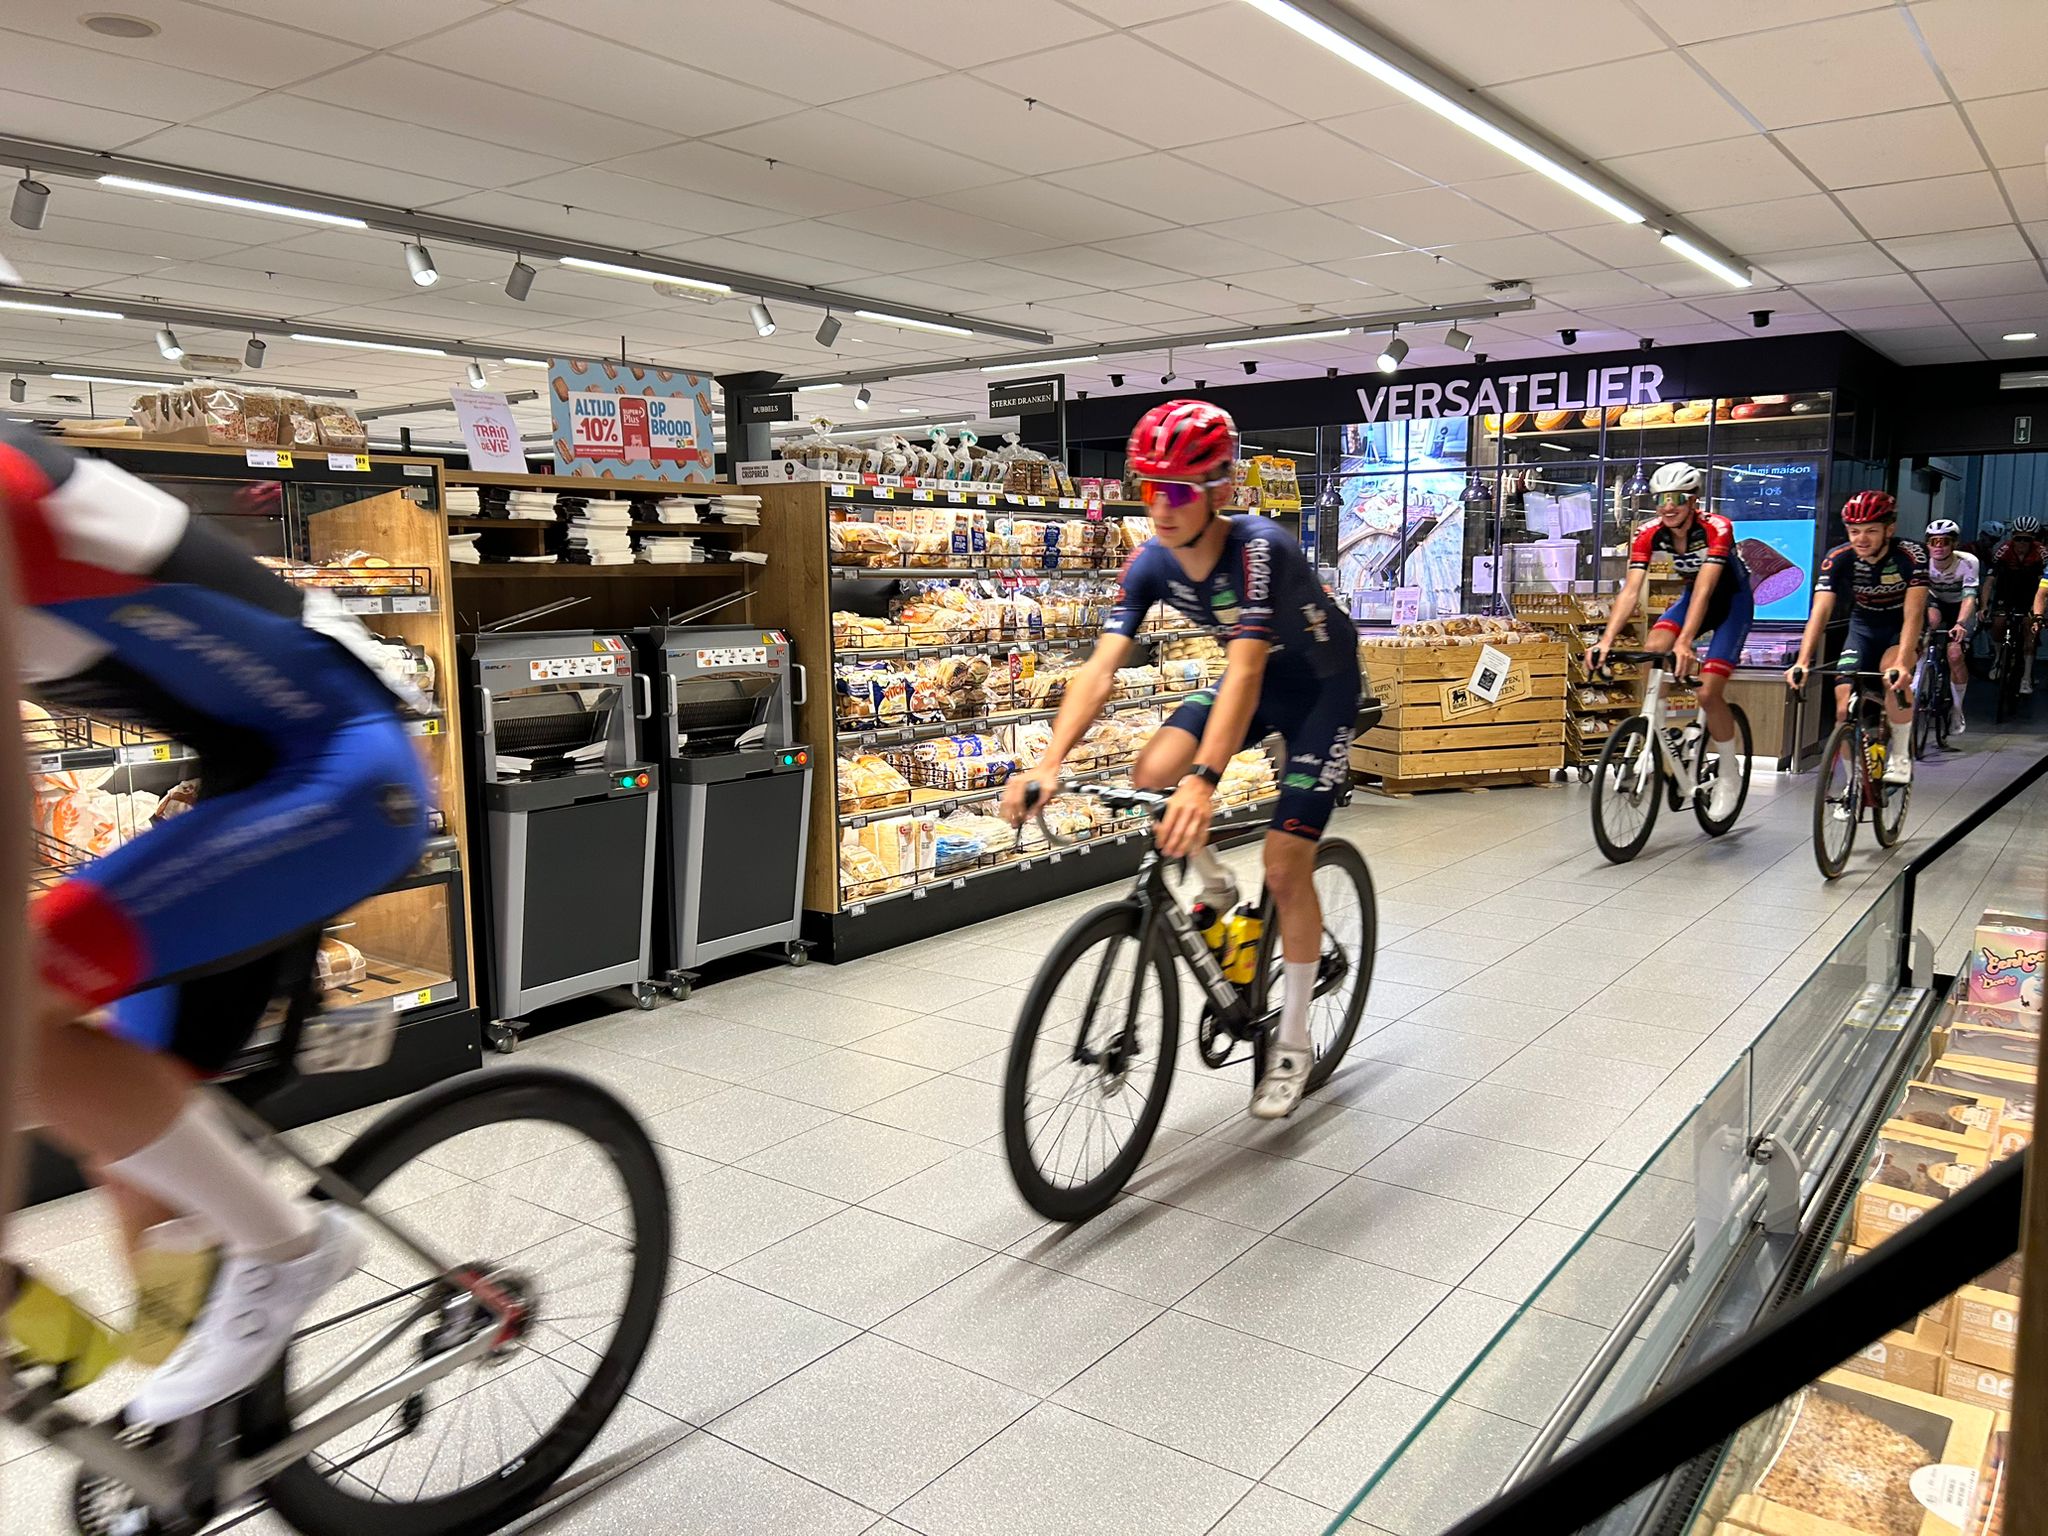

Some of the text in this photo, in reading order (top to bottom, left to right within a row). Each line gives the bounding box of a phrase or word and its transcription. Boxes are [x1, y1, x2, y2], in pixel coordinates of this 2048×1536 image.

[991, 394, 1052, 408] STERKE DRANKEN
[1356, 364, 1664, 424] VERSATELIER
[575, 399, 616, 417] ALTIJD
[649, 401, 666, 417] OP
[752, 405, 779, 414] BUBBELS
[624, 414, 640, 424] Plus
[576, 418, 618, 442] -10%
[651, 419, 692, 436] BROOD
[1771, 465, 1811, 475] maison
[1753, 487, 1782, 496] -10%
